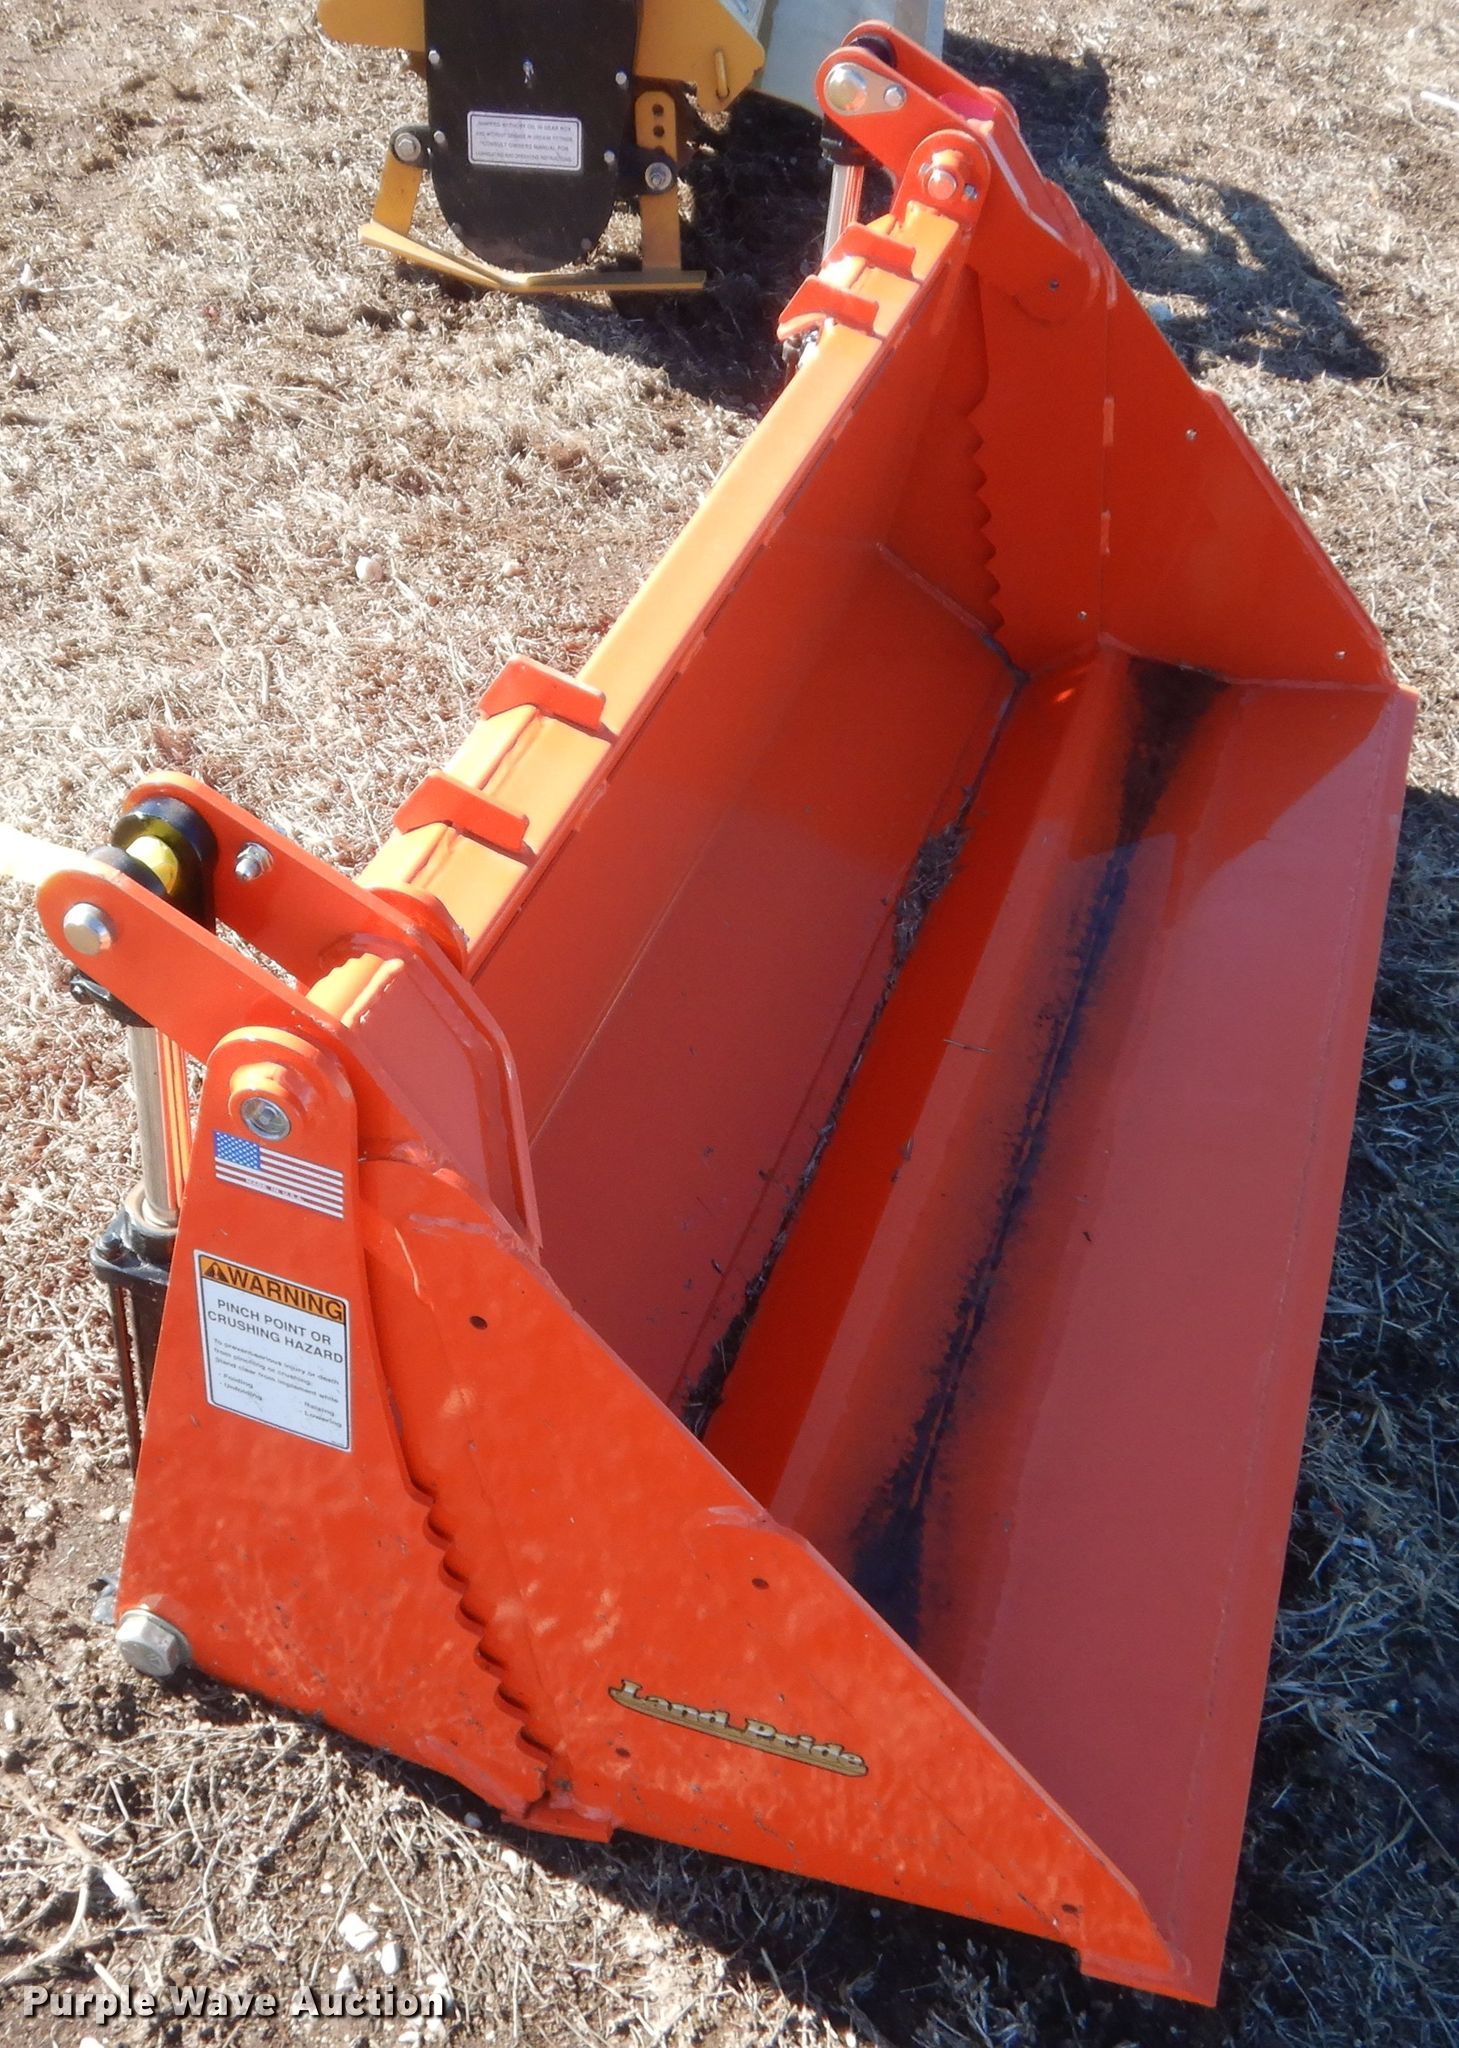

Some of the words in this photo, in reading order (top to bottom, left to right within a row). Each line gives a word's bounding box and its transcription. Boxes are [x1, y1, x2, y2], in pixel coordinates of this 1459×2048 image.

[227, 1266, 342, 1321] WARNING
[207, 1309, 280, 1343] CRUSHING
[284, 1335, 343, 1364] HAZARD
[217, 1298, 259, 1322] PINCH
[264, 1313, 306, 1337] POINT
[310, 1329, 330, 1346] OR
[620, 1679, 730, 1731] Land
[745, 1717, 864, 1769] Pride
